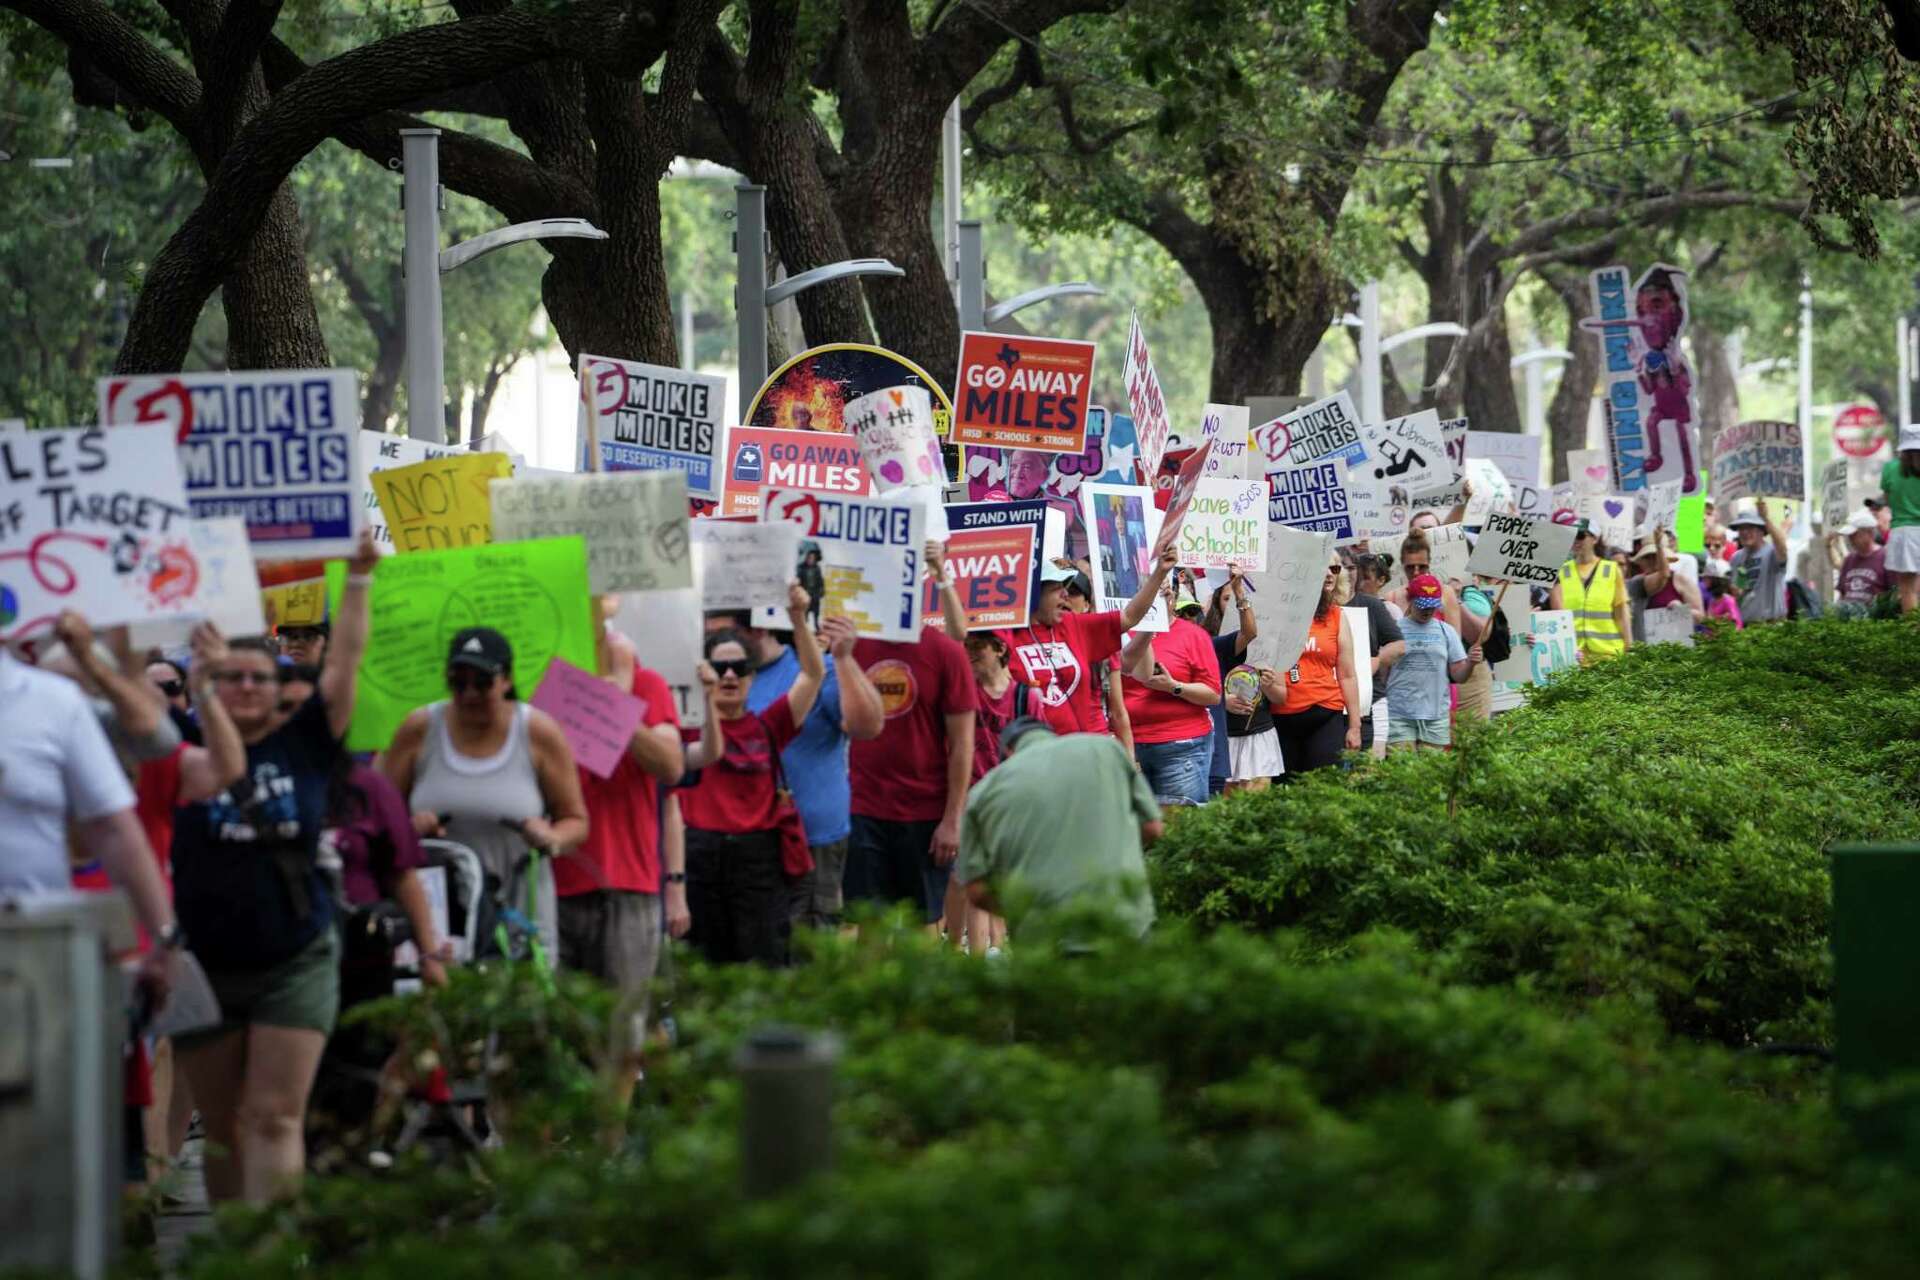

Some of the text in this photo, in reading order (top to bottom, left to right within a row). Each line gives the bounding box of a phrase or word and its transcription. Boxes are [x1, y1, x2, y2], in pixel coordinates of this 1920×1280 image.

[966, 364, 1085, 396] GO AWAY
[185, 380, 334, 434] MIKE
[624, 374, 709, 418] MIKE
[964, 388, 1078, 431] MILES
[615, 409, 714, 456] MILES
[1202, 414, 1220, 435] NO
[1287, 401, 1345, 441] MIKE
[380, 440, 401, 458] WE
[962, 428, 1075, 446] HISD SCHOOLS STRONG
[1289, 421, 1359, 465] MILES
[181, 434, 348, 488] MILES
[616, 448, 666, 470] DESERVES
[669, 457, 708, 477] BETTER
[769, 443, 862, 466] GO AWAY
[768, 461, 861, 492] MILES
[1266, 463, 1338, 497] MIKE
[38, 484, 190, 532] TARGET
[386, 467, 460, 519] NOT
[734, 494, 760, 506] HISD
[1268, 488, 1348, 521] MILES
[815, 499, 909, 546] MIKE
[963, 508, 1043, 526] STAND WITH
[1222, 517, 1259, 537] our
[1487, 514, 1534, 538] PEOPLE
[1499, 539, 1540, 561] OVER
[944, 553, 1023, 579] AWAY
[1502, 560, 1558, 583] PROCESS
[977, 611, 1015, 623] STRONG
